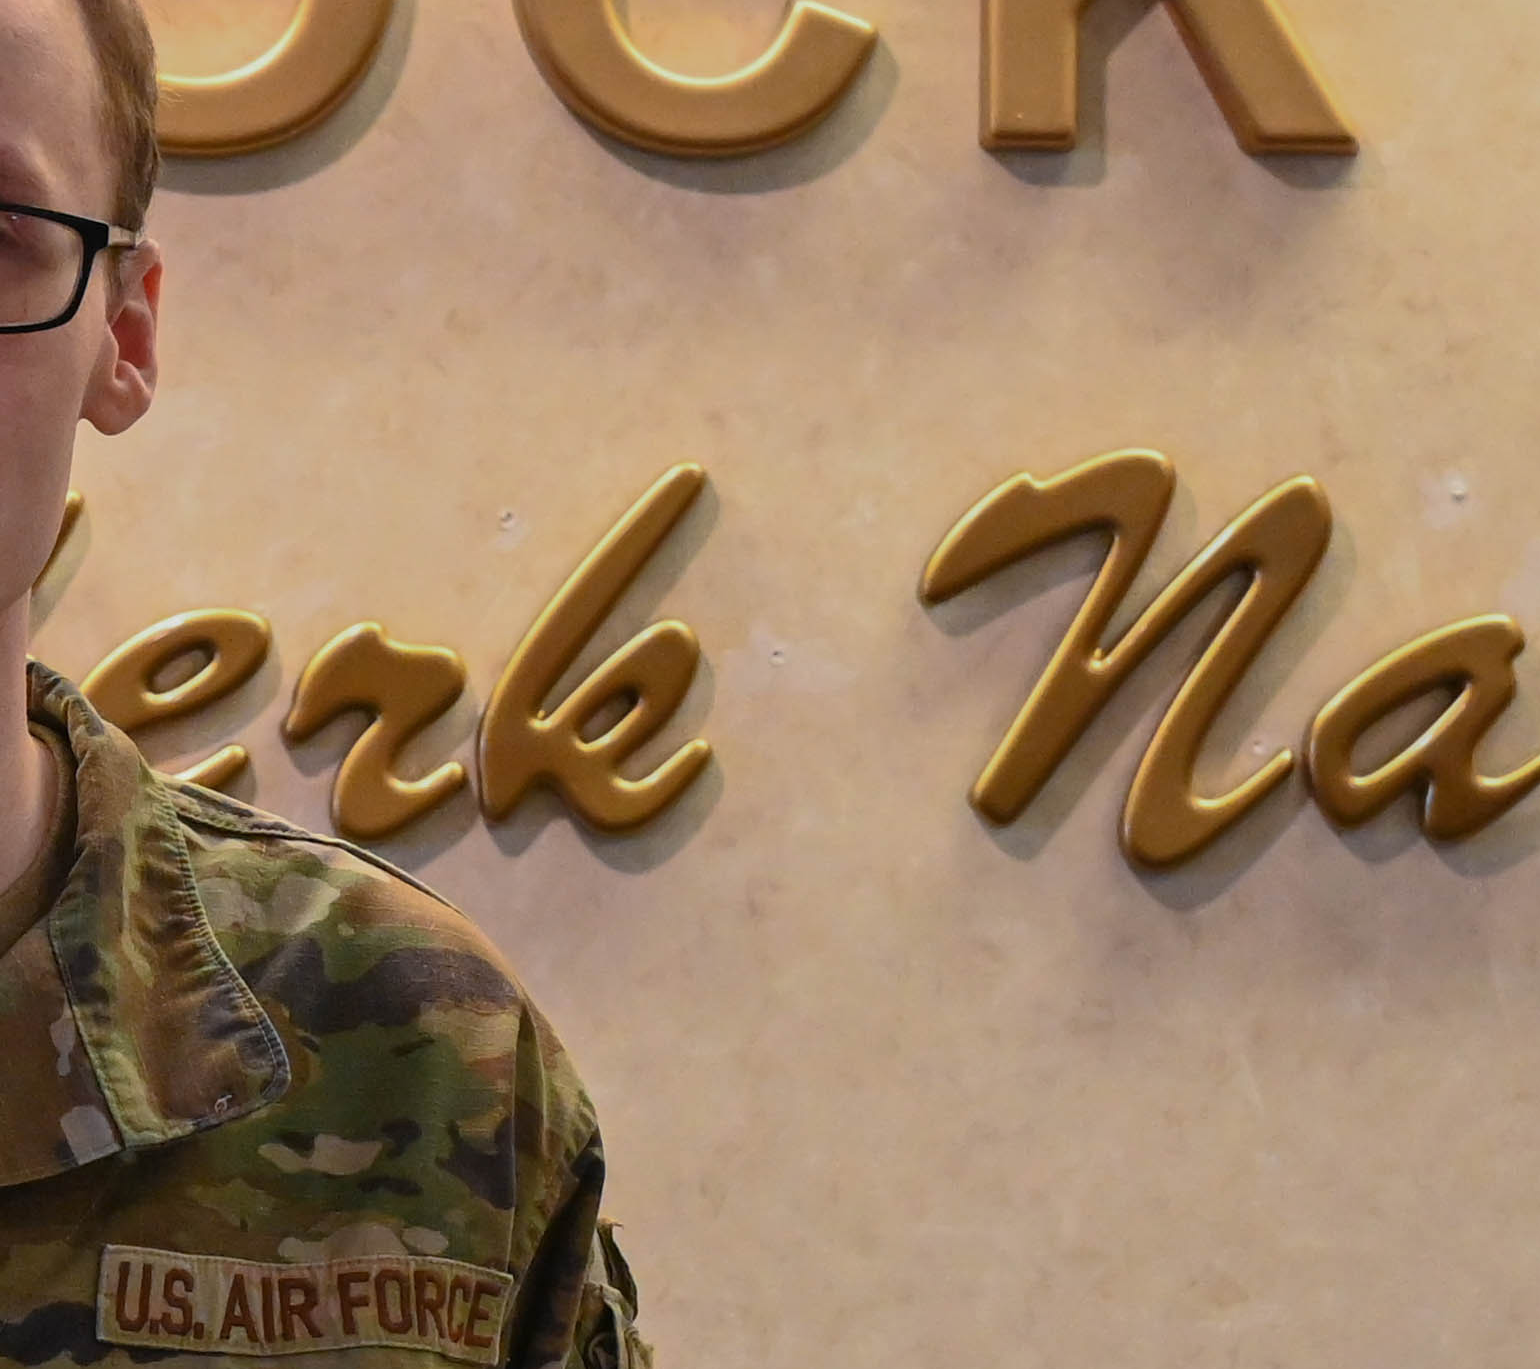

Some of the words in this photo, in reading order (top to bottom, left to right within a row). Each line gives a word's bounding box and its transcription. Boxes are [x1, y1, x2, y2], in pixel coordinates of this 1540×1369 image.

[30, 461, 714, 838] erk
[115, 1261, 204, 1340] U.S.
[220, 1273, 323, 1343] AIR
[336, 1269, 502, 1348] FORCE
